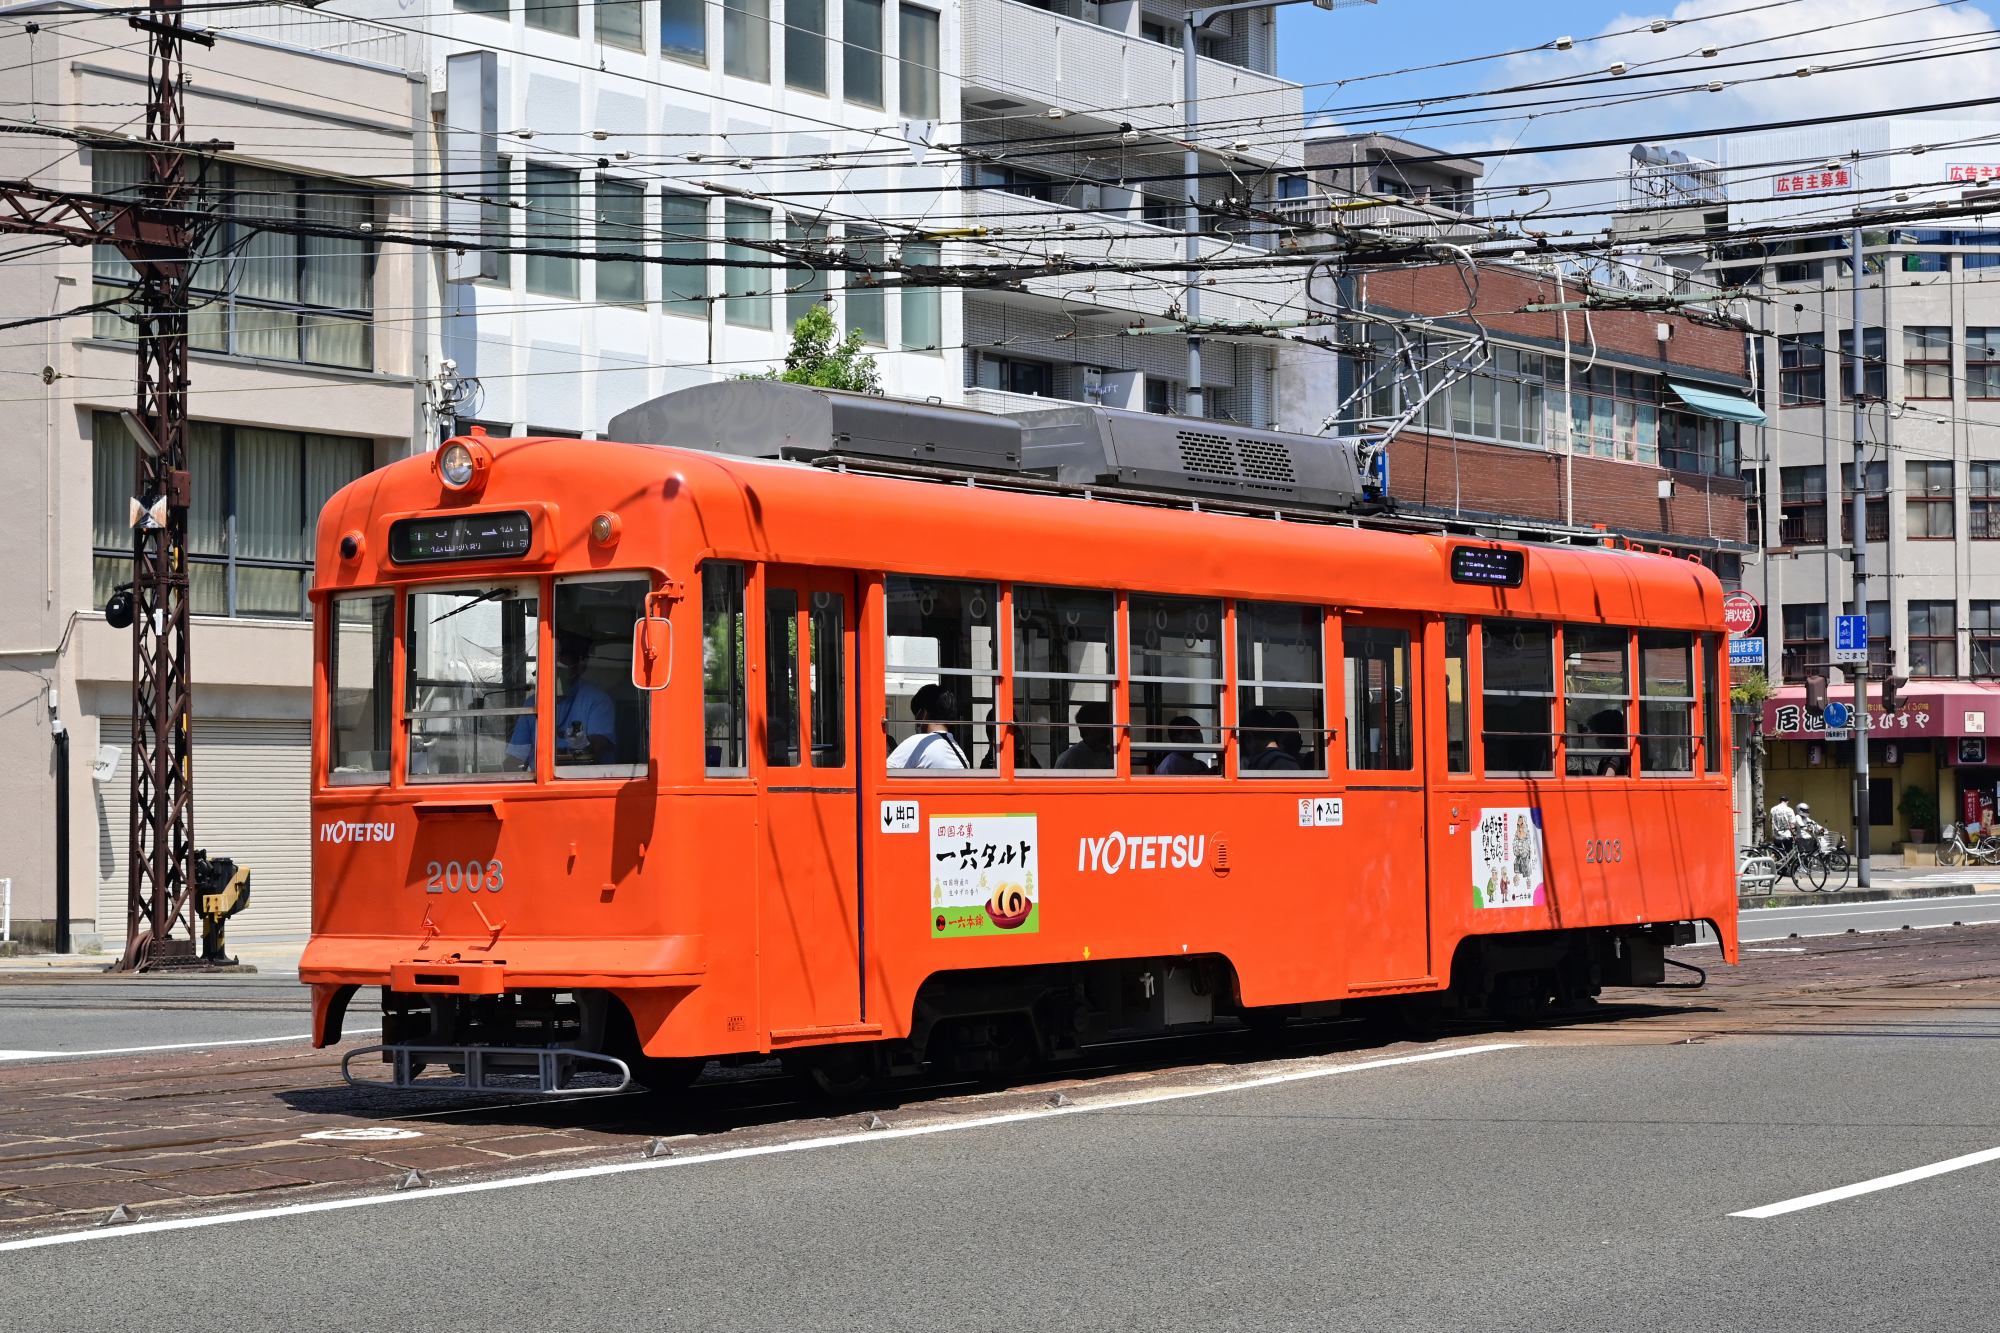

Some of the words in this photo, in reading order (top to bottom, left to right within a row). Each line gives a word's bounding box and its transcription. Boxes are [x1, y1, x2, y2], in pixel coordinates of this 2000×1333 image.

[1777, 170, 1848, 192] 広告主募集
[1725, 608, 1752, 622] 消火栓
[896, 805, 914, 820] 出口
[1325, 802, 1340, 815] 入口
[320, 820, 395, 844] IYOTETSU
[936, 840, 1031, 870] 一六タルト
[1078, 831, 1205, 875] IYOTETSU
[1586, 839, 1622, 864] 2003
[426, 859, 504, 894] 2003
